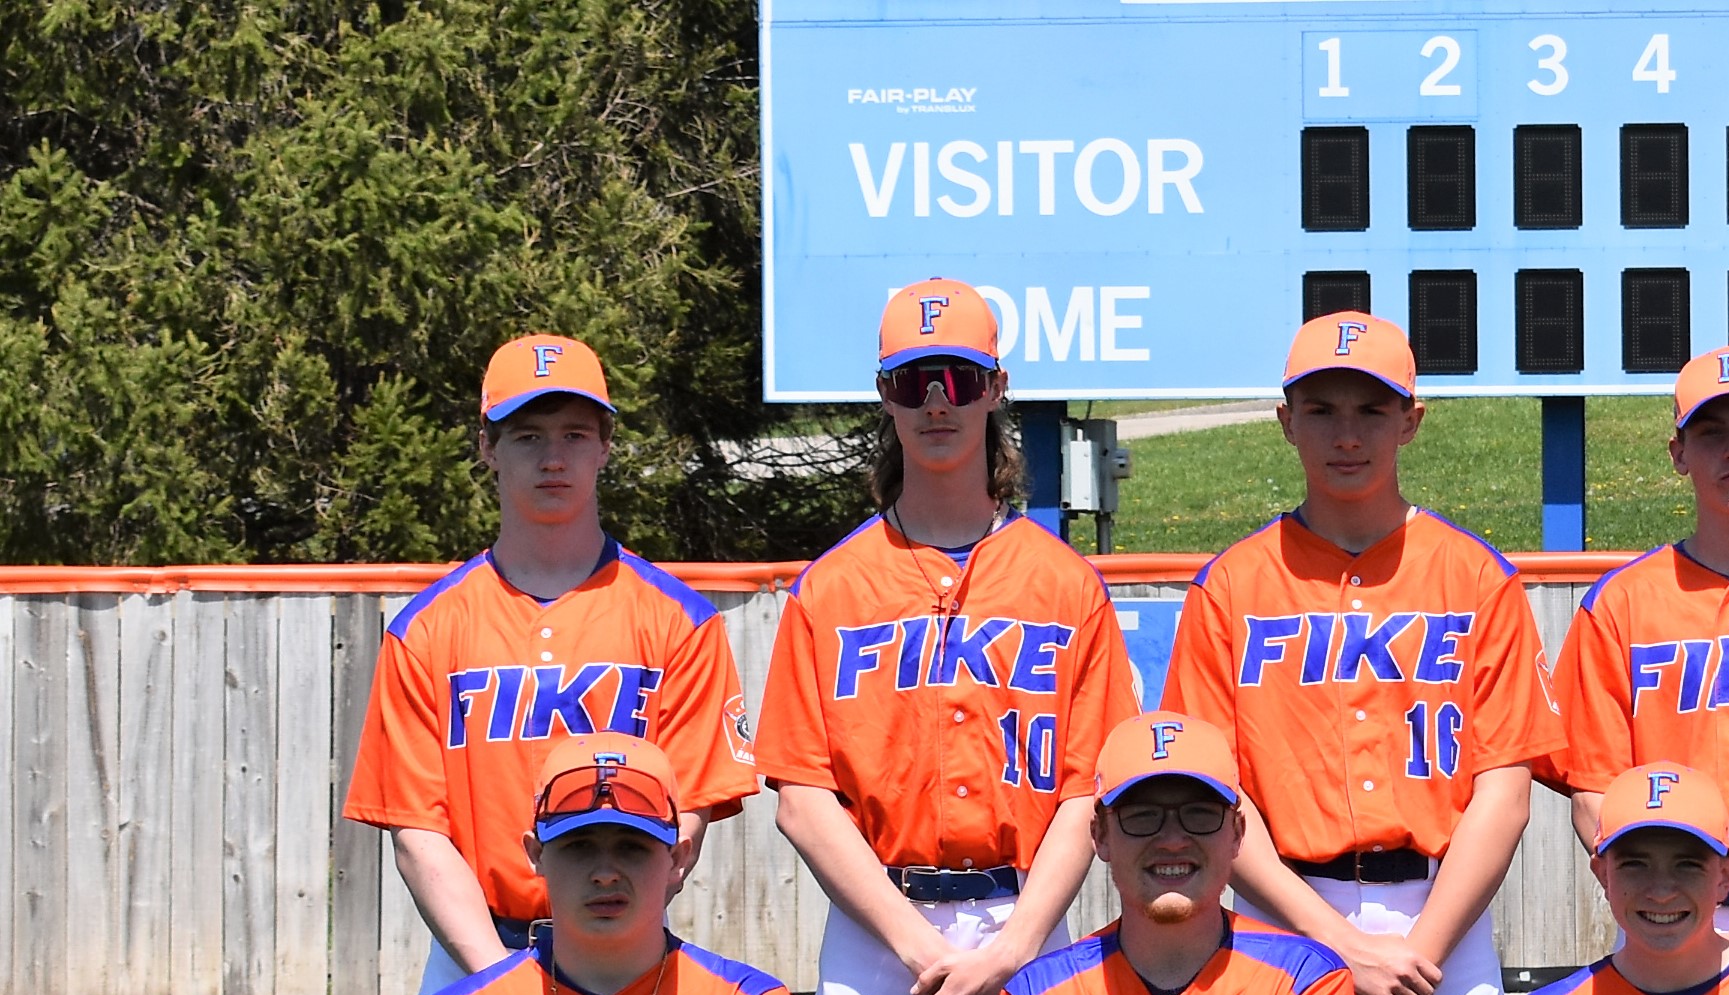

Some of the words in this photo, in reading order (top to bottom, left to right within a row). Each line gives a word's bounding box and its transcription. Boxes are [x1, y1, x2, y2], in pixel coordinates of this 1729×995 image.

[848, 87, 977, 104] FAIR-PLAY
[1317, 36, 1350, 98] 1
[1419, 36, 1463, 97] 2
[1527, 34, 1570, 96] 3
[1632, 33, 1677, 94] 4
[896, 105, 910, 114] by
[911, 104, 977, 113] TRANSLUX
[848, 137, 1205, 218] VISITOR
[887, 285, 1151, 362] ME
[919, 297, 949, 335] F
[1336, 321, 1368, 356] F
[532, 344, 563, 376] F
[834, 613, 1076, 699] FIKE
[1239, 611, 1473, 687] FIKE
[446, 662, 665, 749] FIKE
[1000, 707, 1058, 794] 10
[1150, 721, 1184, 760] F
[1405, 701, 1465, 780] 16
[1646, 771, 1679, 809] F
